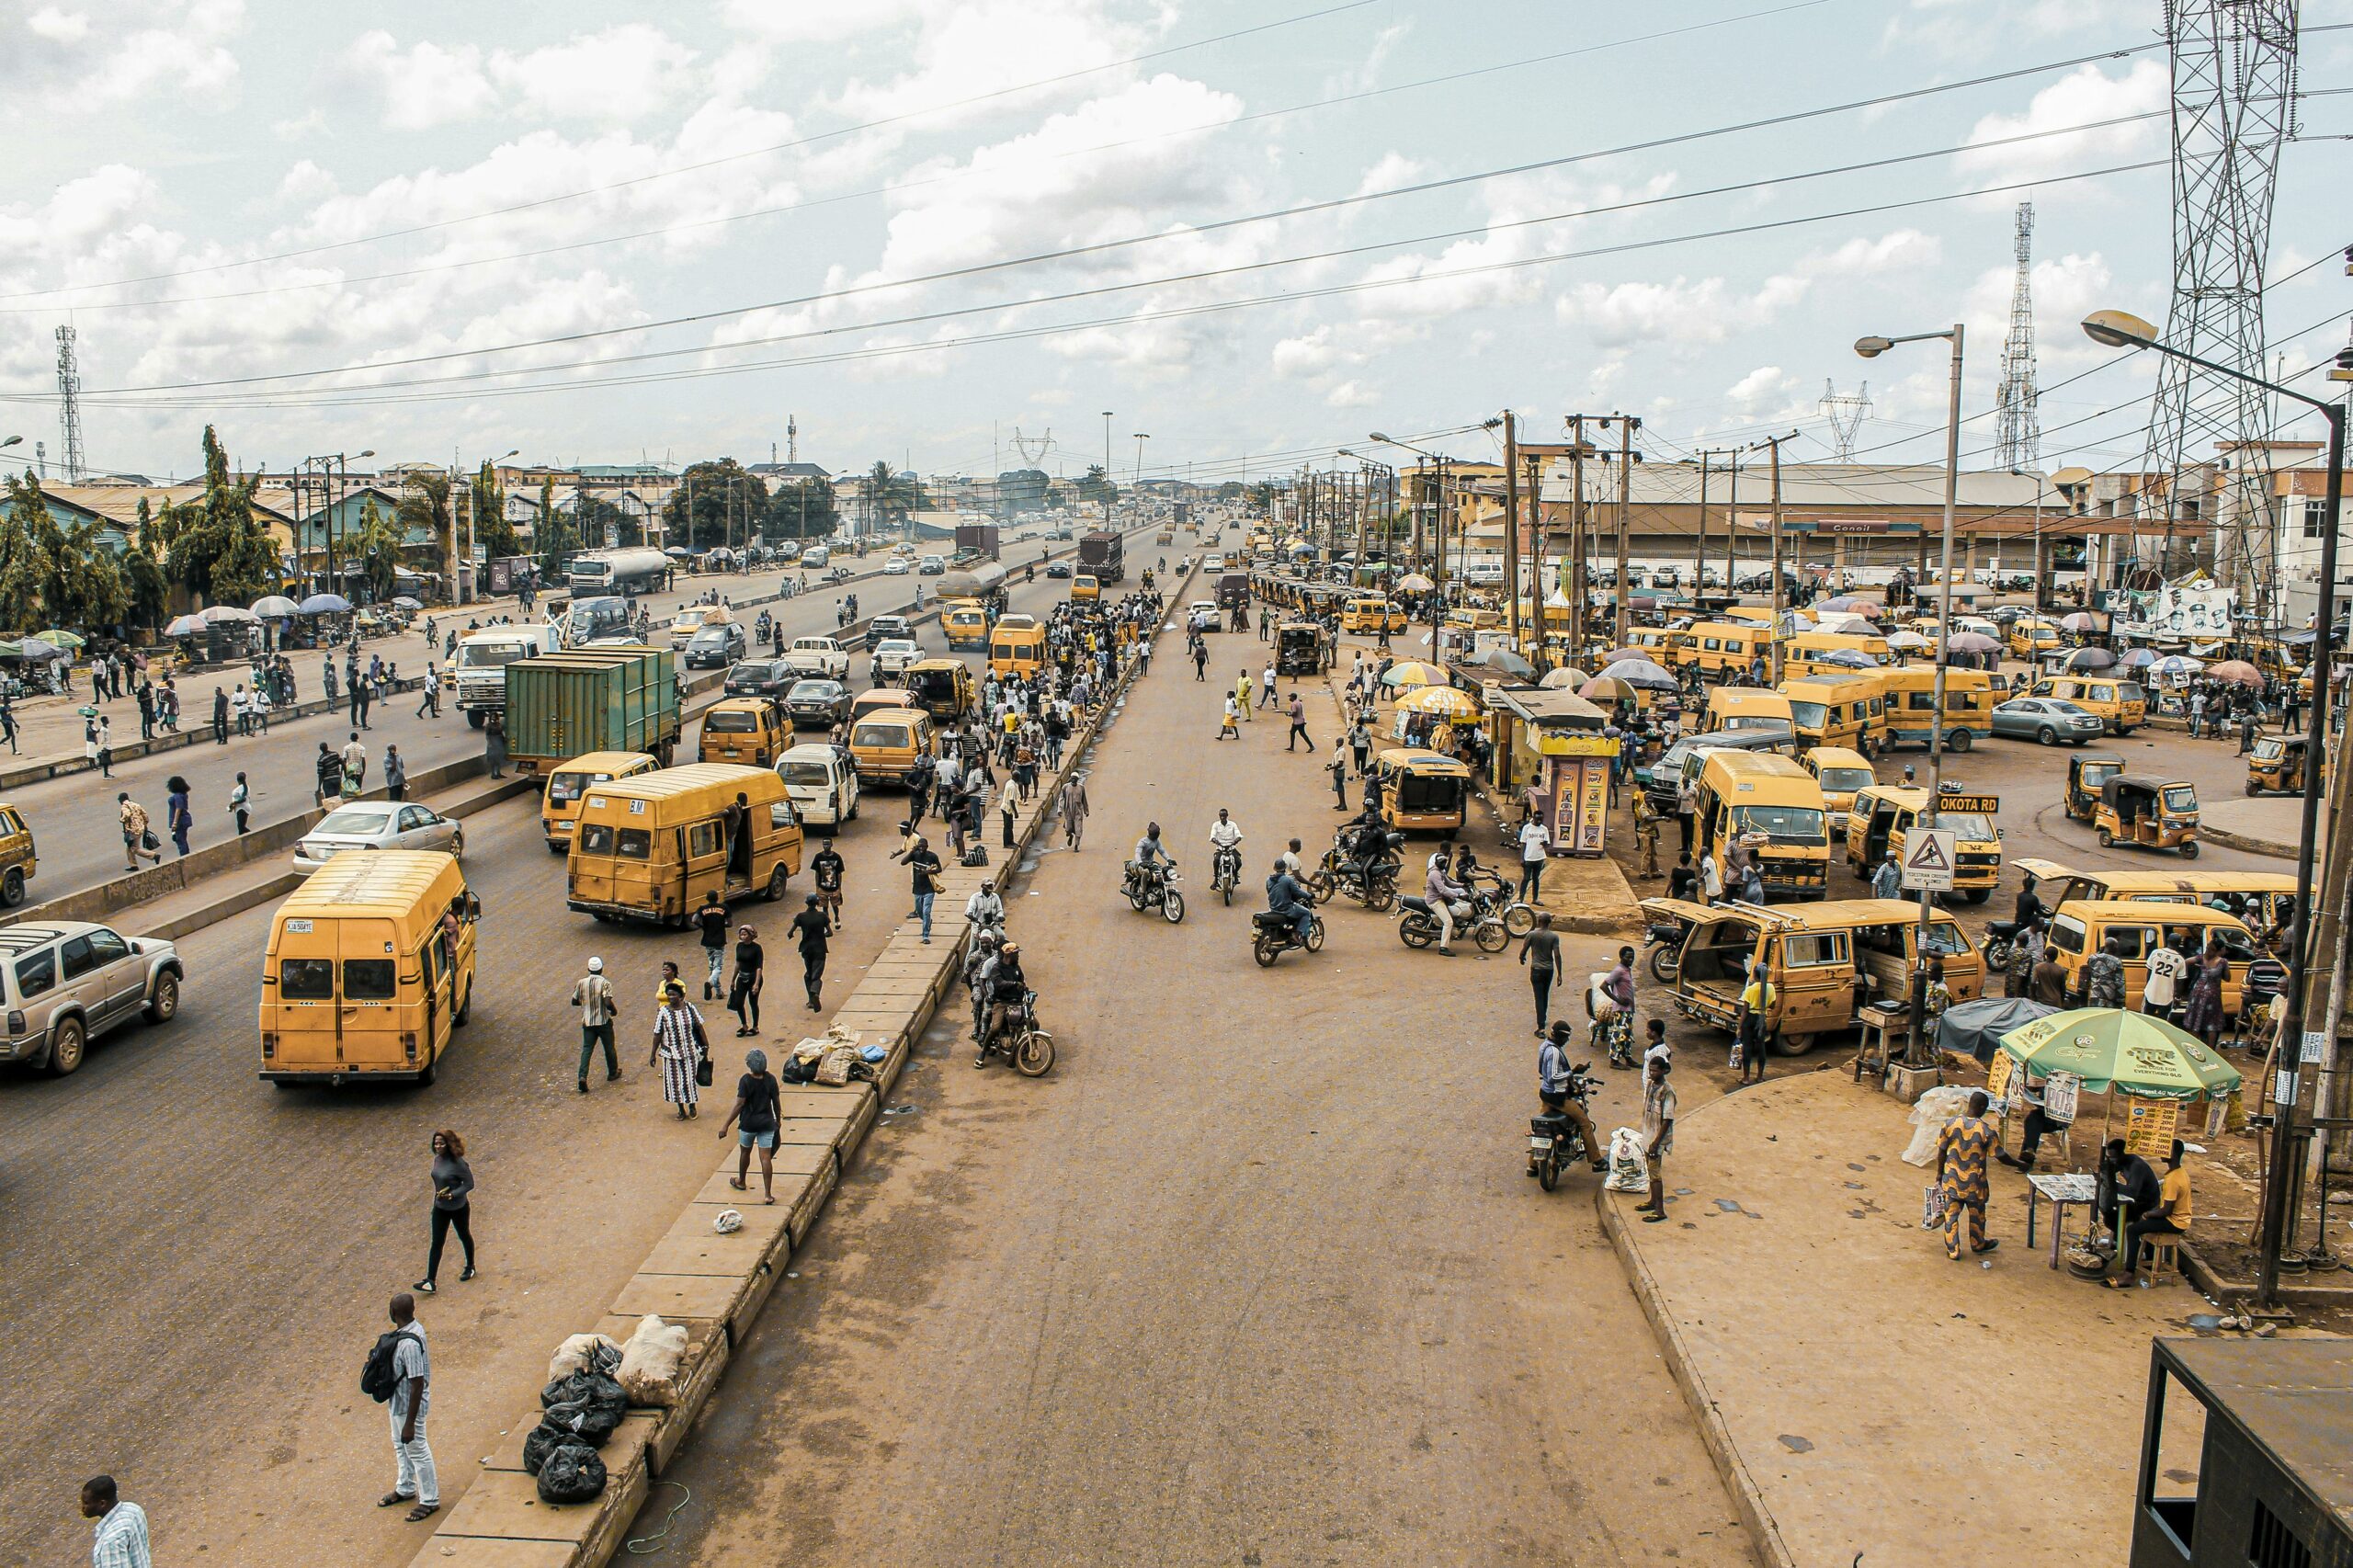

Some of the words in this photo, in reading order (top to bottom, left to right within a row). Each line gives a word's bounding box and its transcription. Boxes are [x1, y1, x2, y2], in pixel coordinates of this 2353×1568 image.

[1833, 524, 1870, 532] Conoil
[1941, 798, 1977, 811] OKOTA
[1981, 799, 1996, 812] RD
[2154, 960, 2174, 978] 22
[2133, 1069, 2169, 1077] EVERYTHING
[2046, 1086, 2075, 1113] POS
[2046, 1107, 2074, 1119] AVAILABLE
